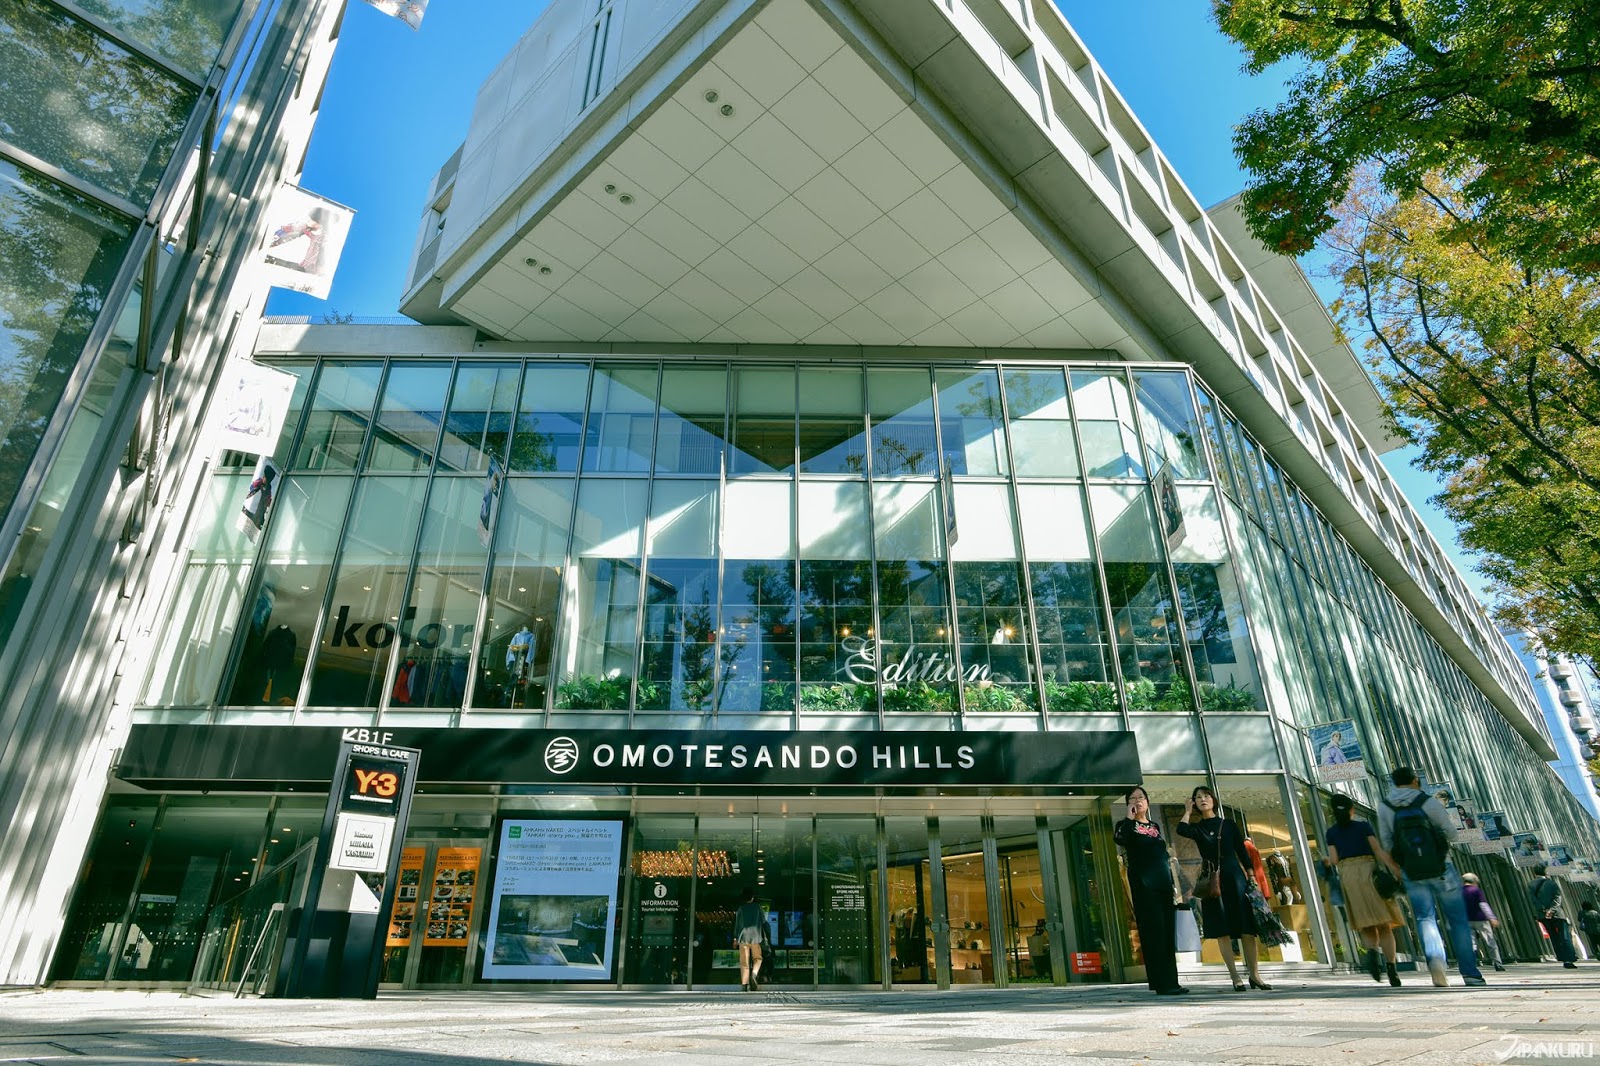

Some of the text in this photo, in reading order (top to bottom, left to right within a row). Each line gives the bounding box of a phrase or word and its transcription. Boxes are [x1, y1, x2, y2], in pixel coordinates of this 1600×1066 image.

[331, 605, 474, 649] kolor
[832, 635, 993, 685] Edition
[357, 728, 393, 745] B1F
[352, 744, 410, 759] SHOPS & CAFE
[593, 744, 975, 768] OMOTESANDO HILLS
[355, 769, 397, 796] Y-3
